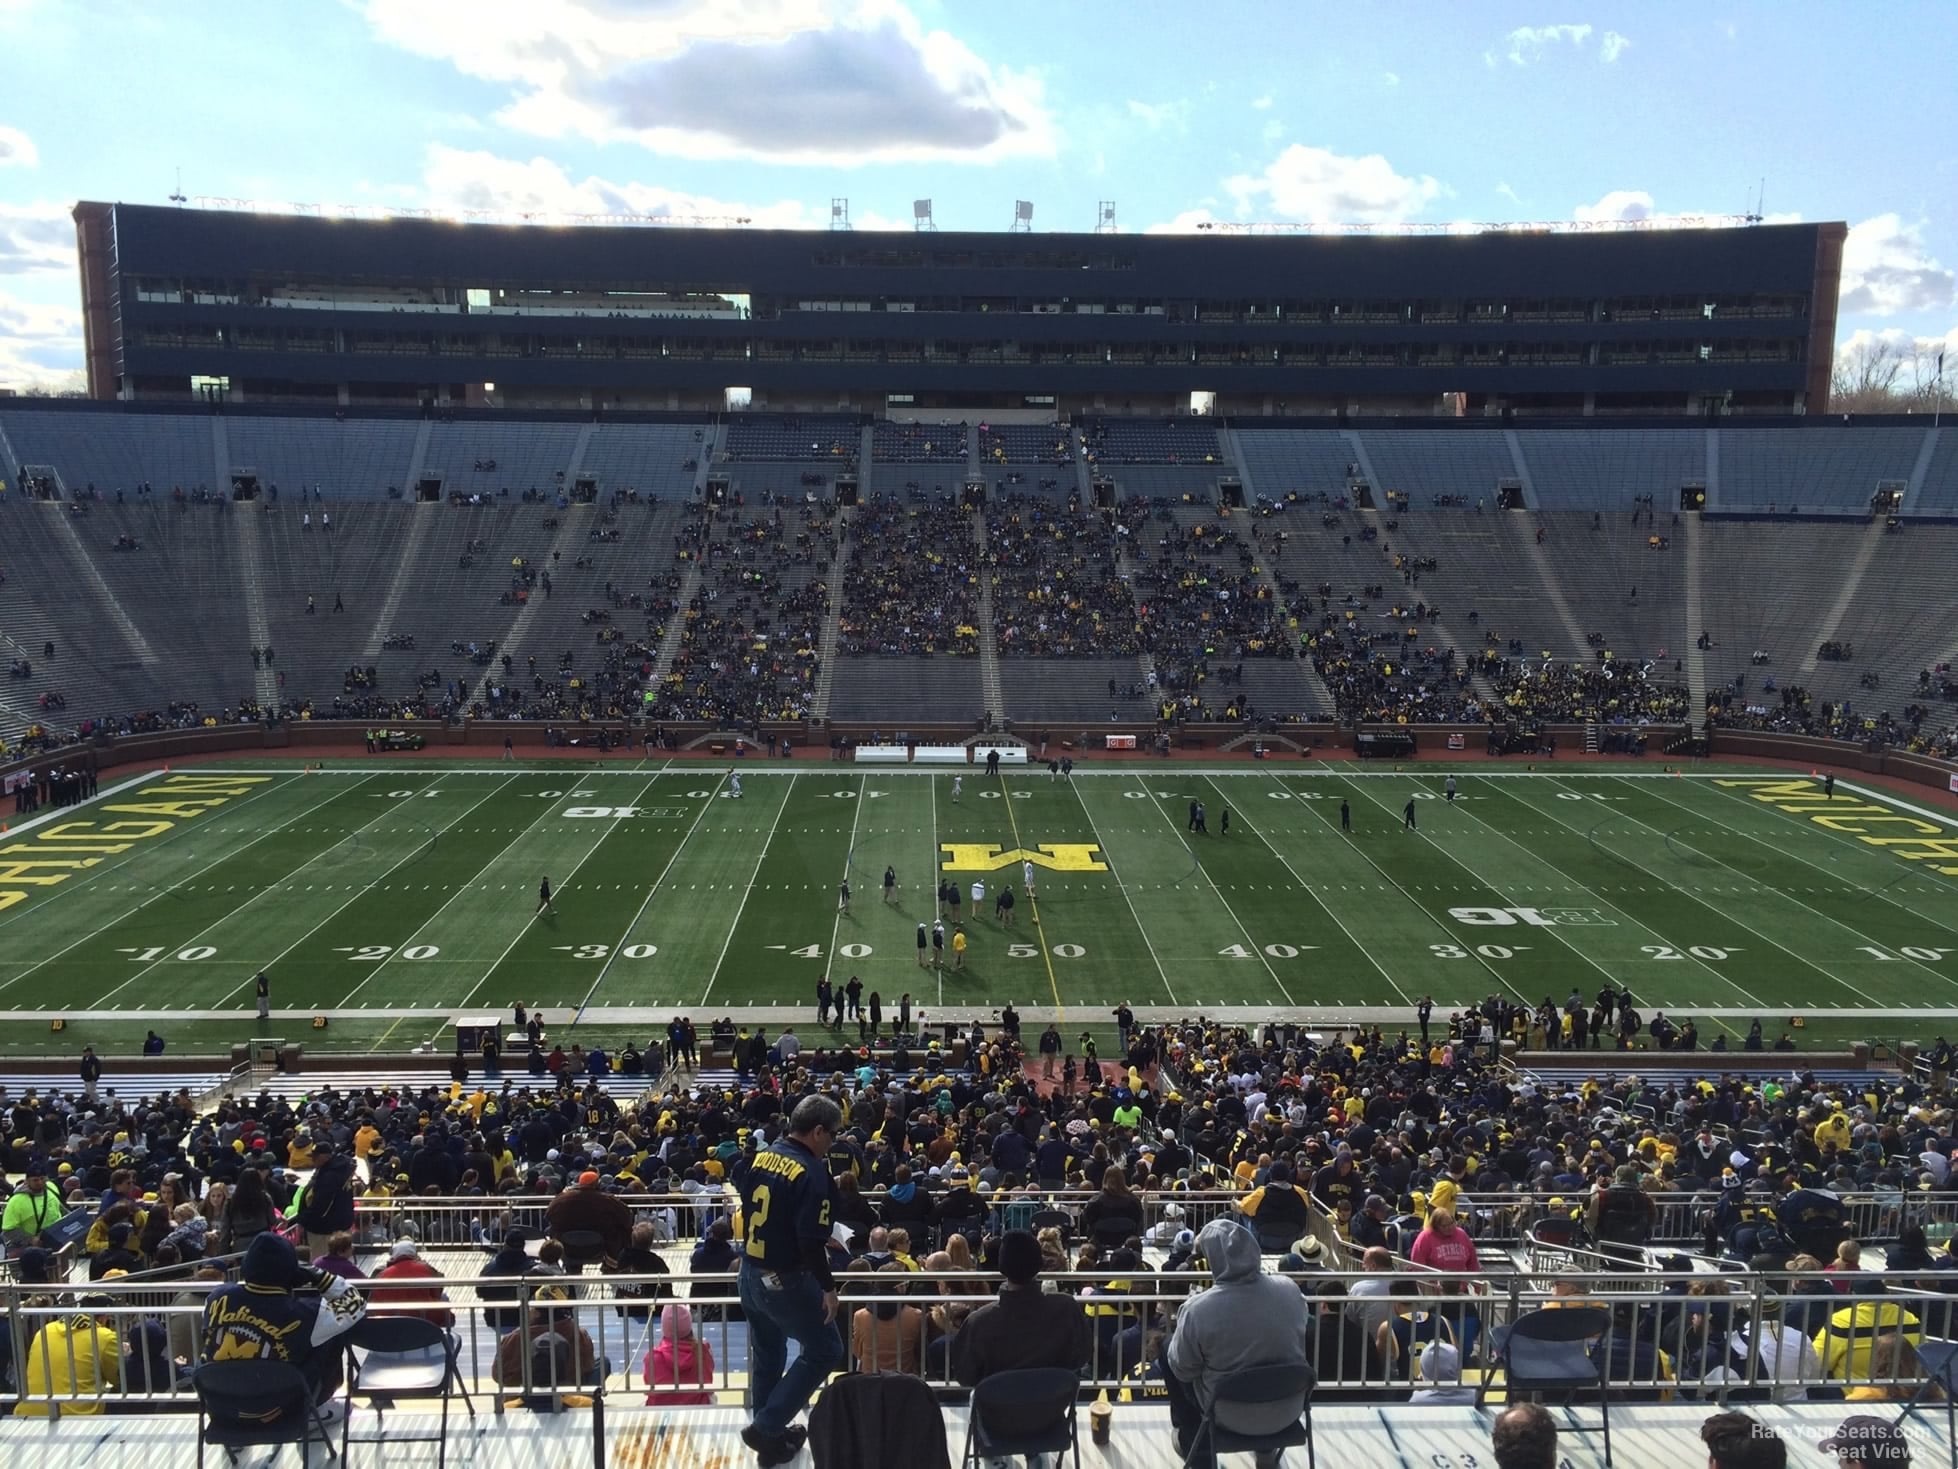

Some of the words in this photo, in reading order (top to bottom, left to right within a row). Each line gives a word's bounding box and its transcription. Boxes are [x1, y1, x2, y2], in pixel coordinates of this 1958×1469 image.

[1711, 779, 1958, 881] MICH
[128, 946, 217, 961] 10
[348, 945, 440, 960] 20
[573, 944, 658, 959] 30
[789, 943, 873, 958] 40
[1007, 943, 1086, 958] 50
[1217, 943, 1299, 958] 40
[1428, 944, 1513, 959] 30
[1640, 945, 1729, 960] 20
[1855, 946, 1944, 961] 10
[818, 1199, 830, 1226] 2
[746, 1184, 770, 1259] 2
[209, 1296, 302, 1341] National
